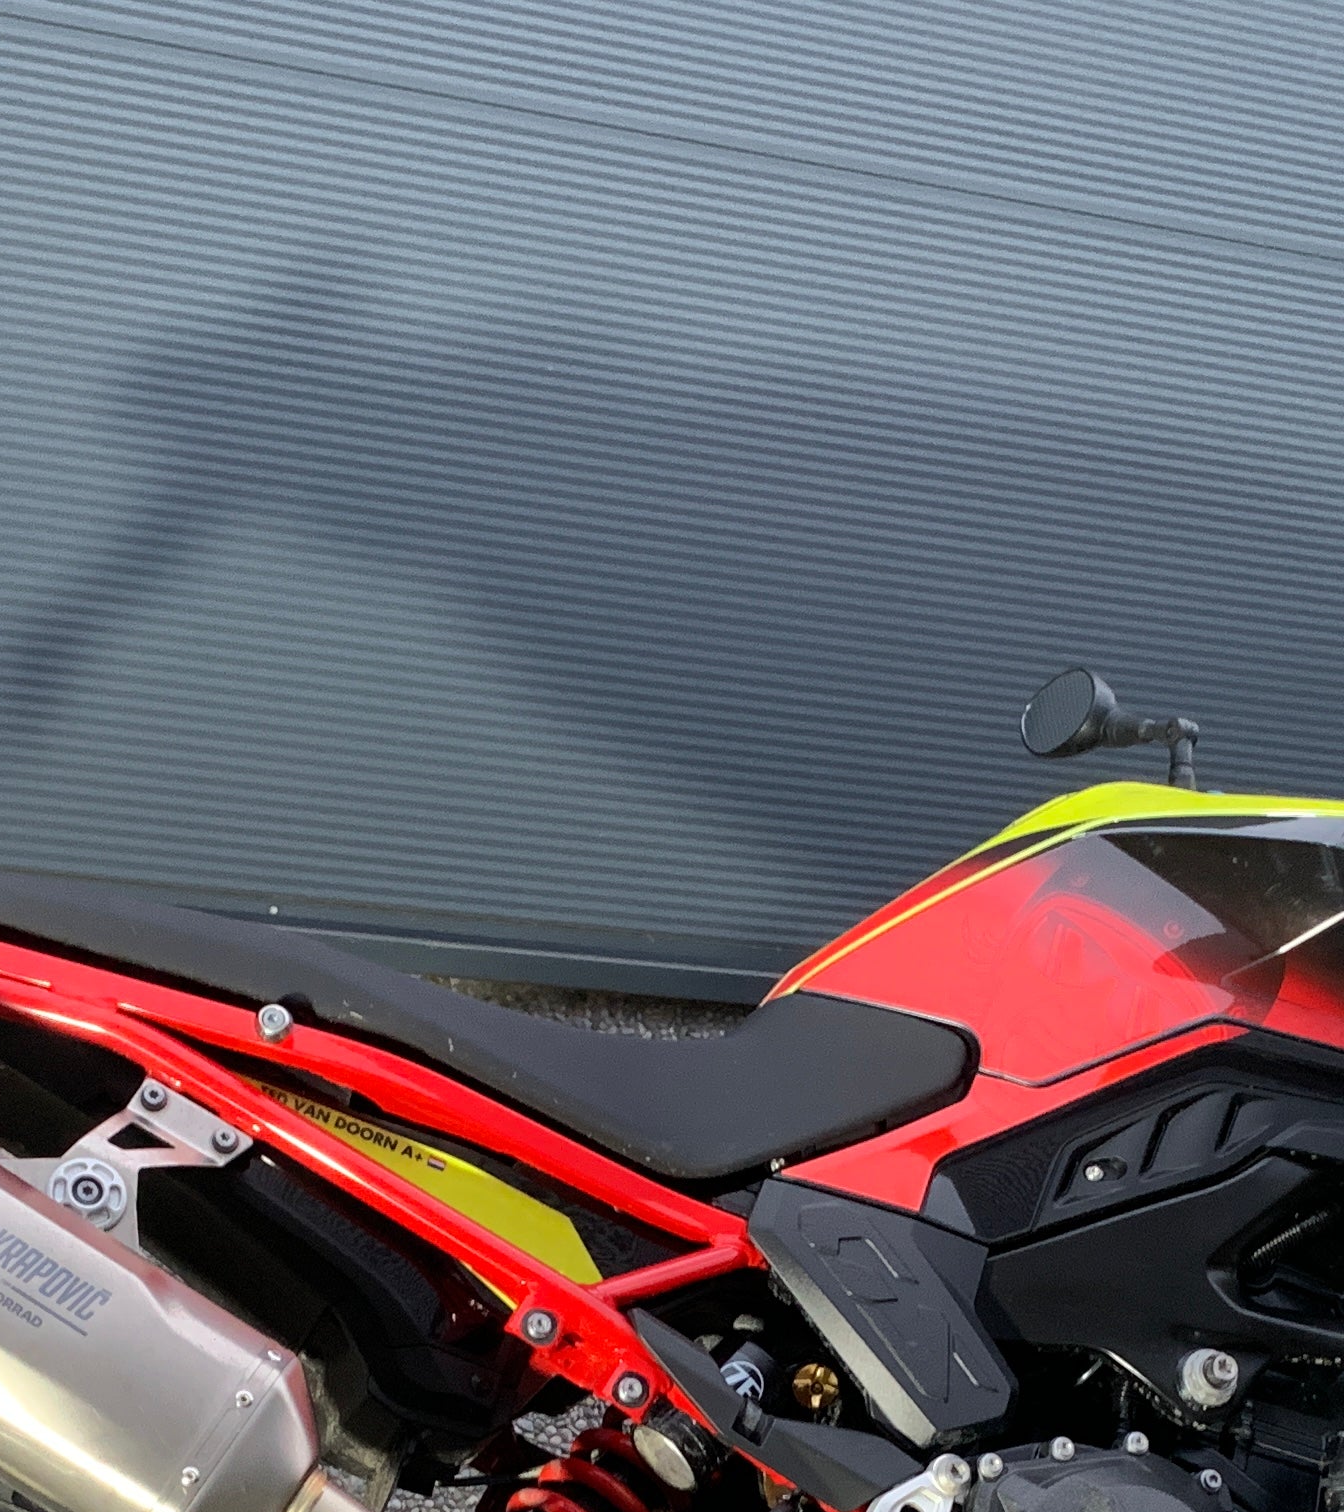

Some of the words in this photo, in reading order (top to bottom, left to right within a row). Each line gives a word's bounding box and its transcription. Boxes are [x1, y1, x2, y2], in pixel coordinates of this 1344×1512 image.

[294, 1099, 332, 1125] VAN
[333, 1115, 400, 1153] DOORN
[400, 1144, 424, 1162] A+
